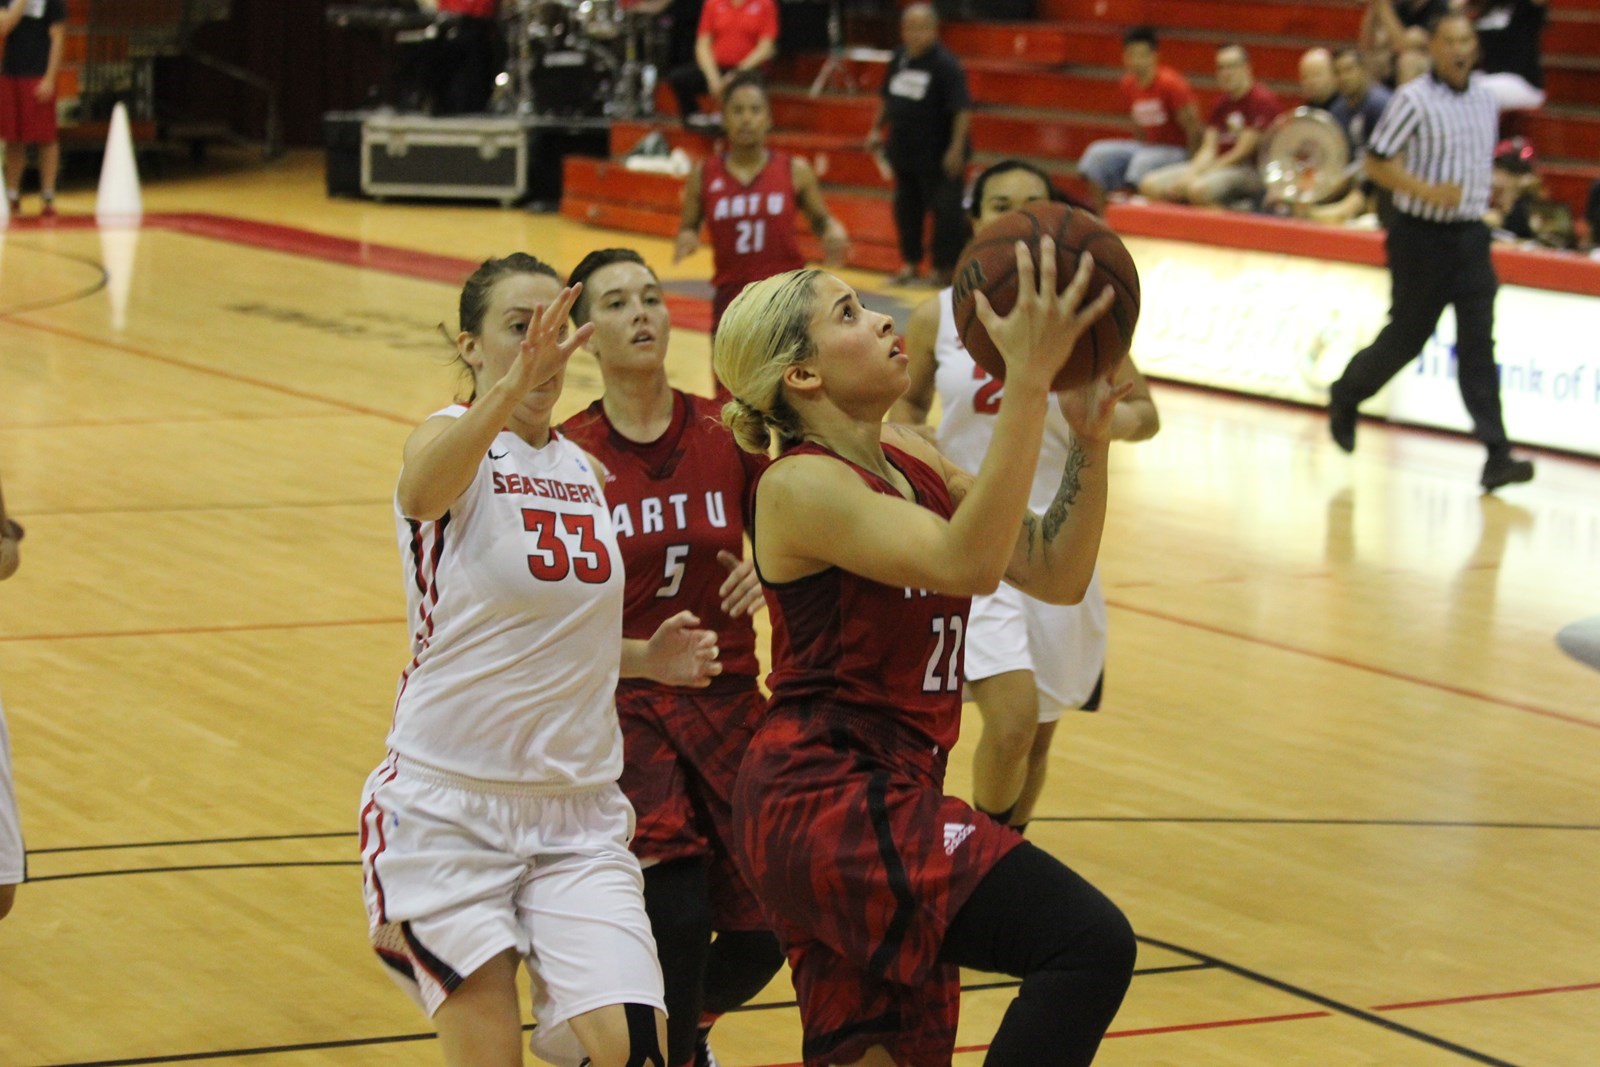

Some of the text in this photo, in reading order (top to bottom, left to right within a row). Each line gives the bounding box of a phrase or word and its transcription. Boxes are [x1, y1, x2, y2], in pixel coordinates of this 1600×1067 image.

[714, 191, 785, 221] ART U
[734, 219, 765, 255] 21
[611, 490, 728, 539] ART U
[521, 508, 612, 584] 33
[655, 544, 690, 598] 5
[922, 615, 963, 692] 22
